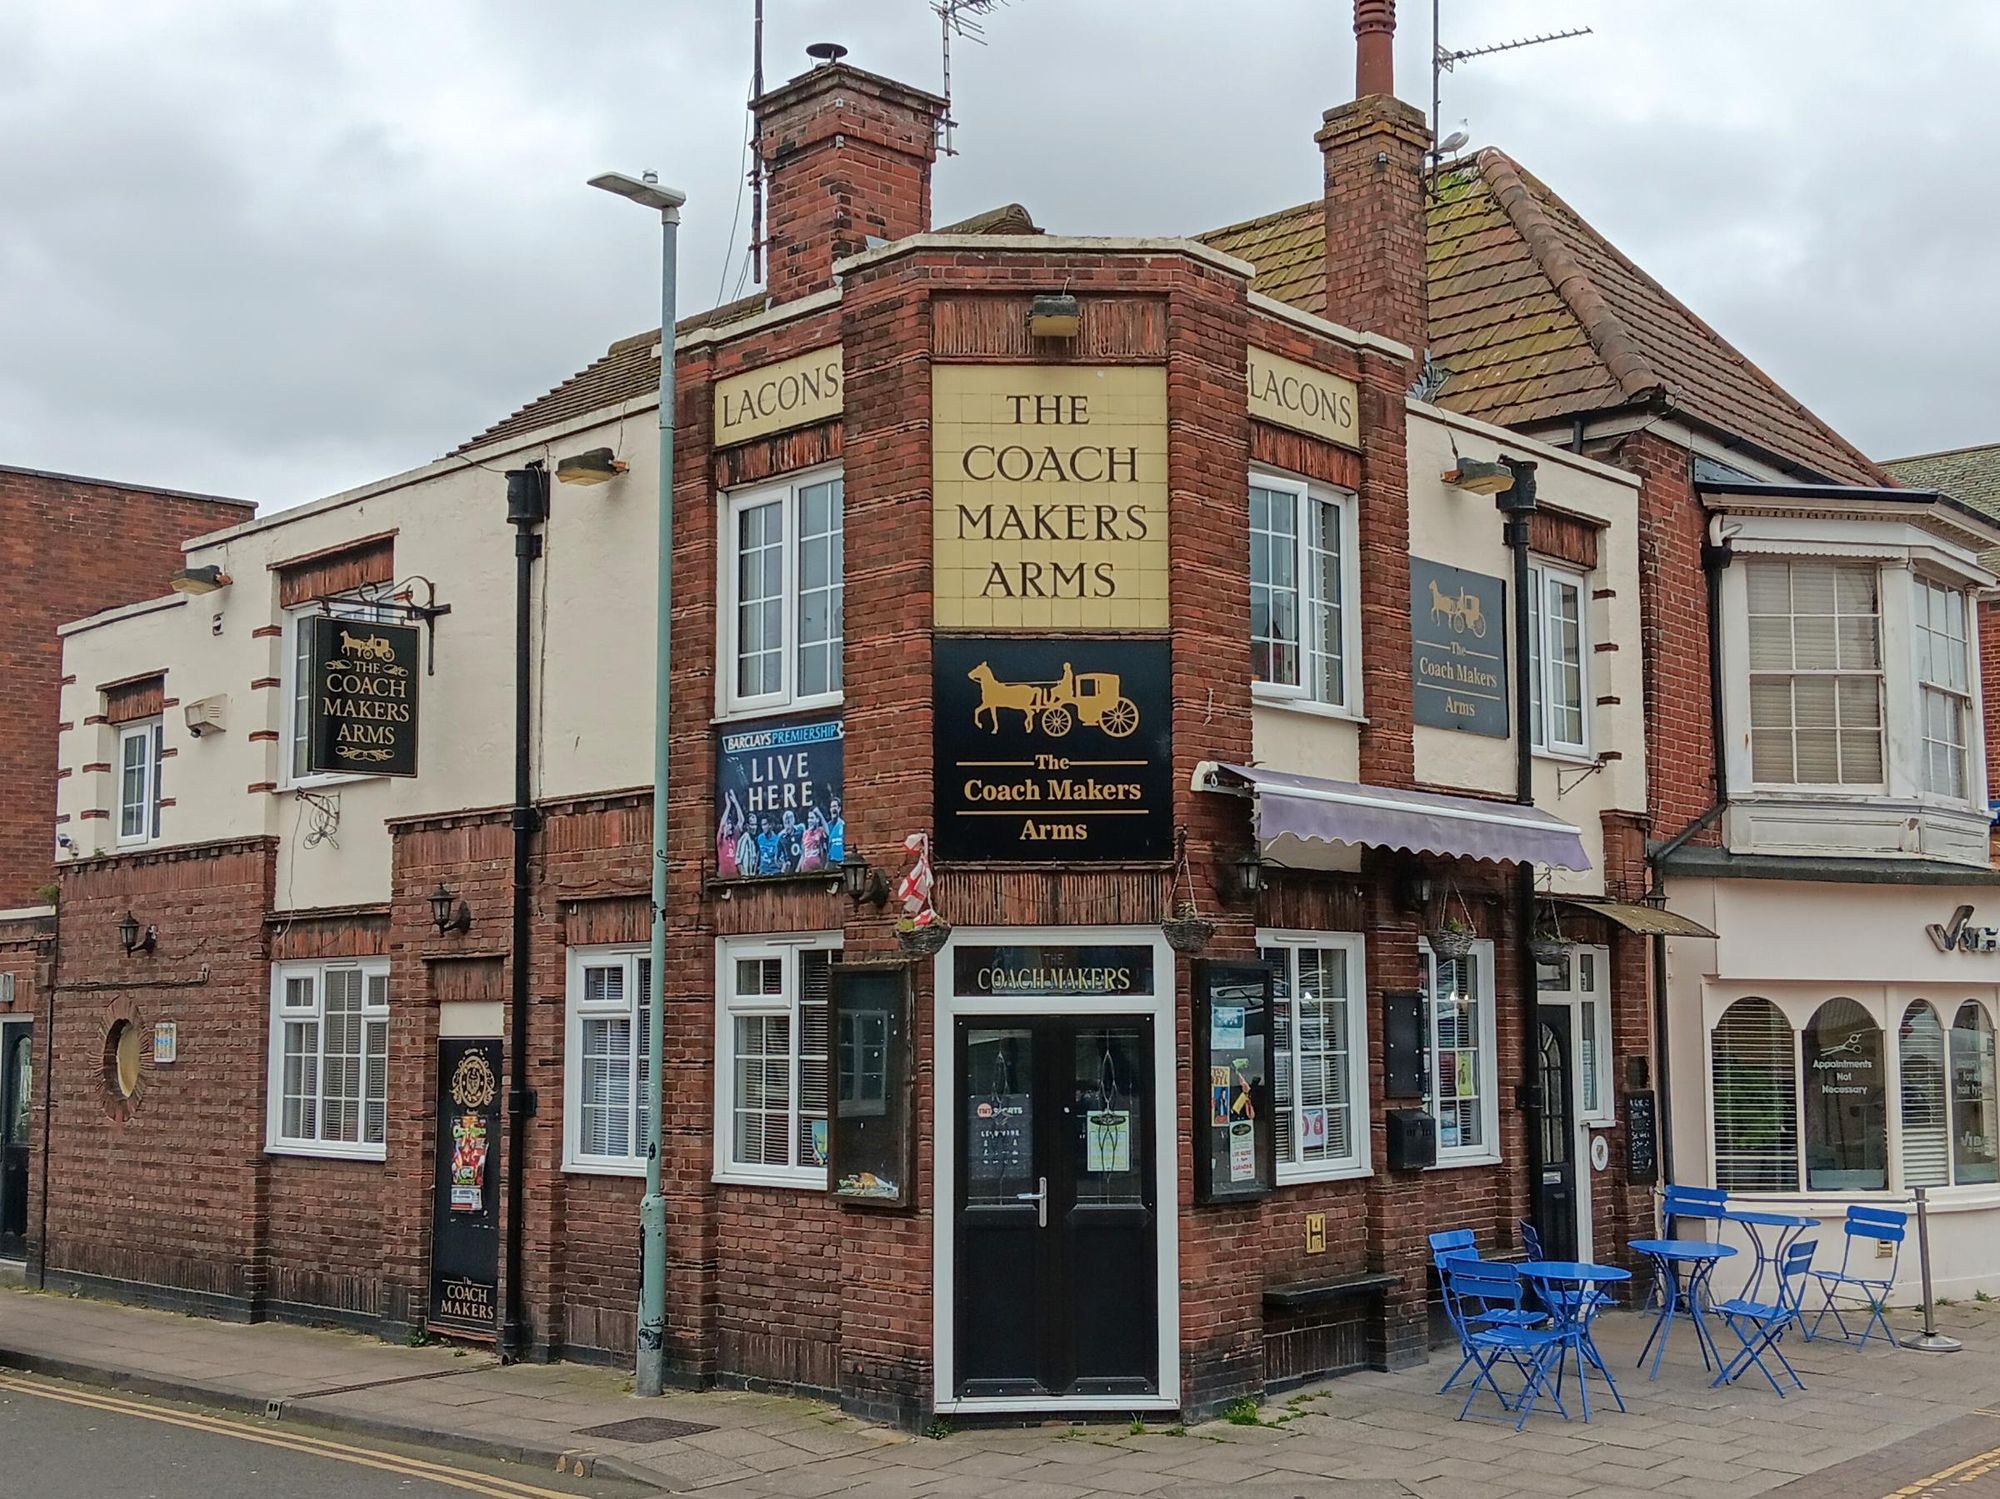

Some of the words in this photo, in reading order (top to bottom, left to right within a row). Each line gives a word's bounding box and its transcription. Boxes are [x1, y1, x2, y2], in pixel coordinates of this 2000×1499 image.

[722, 363, 839, 429] LACONS
[1250, 363, 1352, 428] LACONS
[1006, 395, 1090, 425] THE
[962, 445, 1139, 483] COACH
[955, 504, 1147, 541] MAKERS
[980, 561, 1116, 598] ARMS
[1450, 641, 1467, 656] The
[353, 660, 381, 674] THE
[1419, 656, 1455, 679] Coach
[1456, 664, 1498, 688] Makers
[326, 673, 406, 698] COACH
[323, 697, 410, 722] MAKERS
[1445, 696, 1475, 716] Arms
[336, 723, 395, 745] ARMS
[727, 733, 771, 751] BARCLAYS
[772, 724, 837, 744] PREMIERSHIP
[751, 752, 809, 783] LIVE
[1034, 754, 1070, 770] The
[748, 781, 814, 811] HERE
[963, 779, 1041, 801] Coach
[1047, 779, 1142, 801] Makers
[1019, 819, 1088, 840] Arms
[977, 967, 1045, 990] COACH
[1049, 967, 1131, 990] MAKERS
[1813, 1060, 1872, 1070] Appointments
[1836, 1072, 1852, 1081] Not
[1822, 1085, 1868, 1095] Necessary
[446, 1285, 488, 1303] COACH
[441, 1299, 494, 1320] MAKERS
